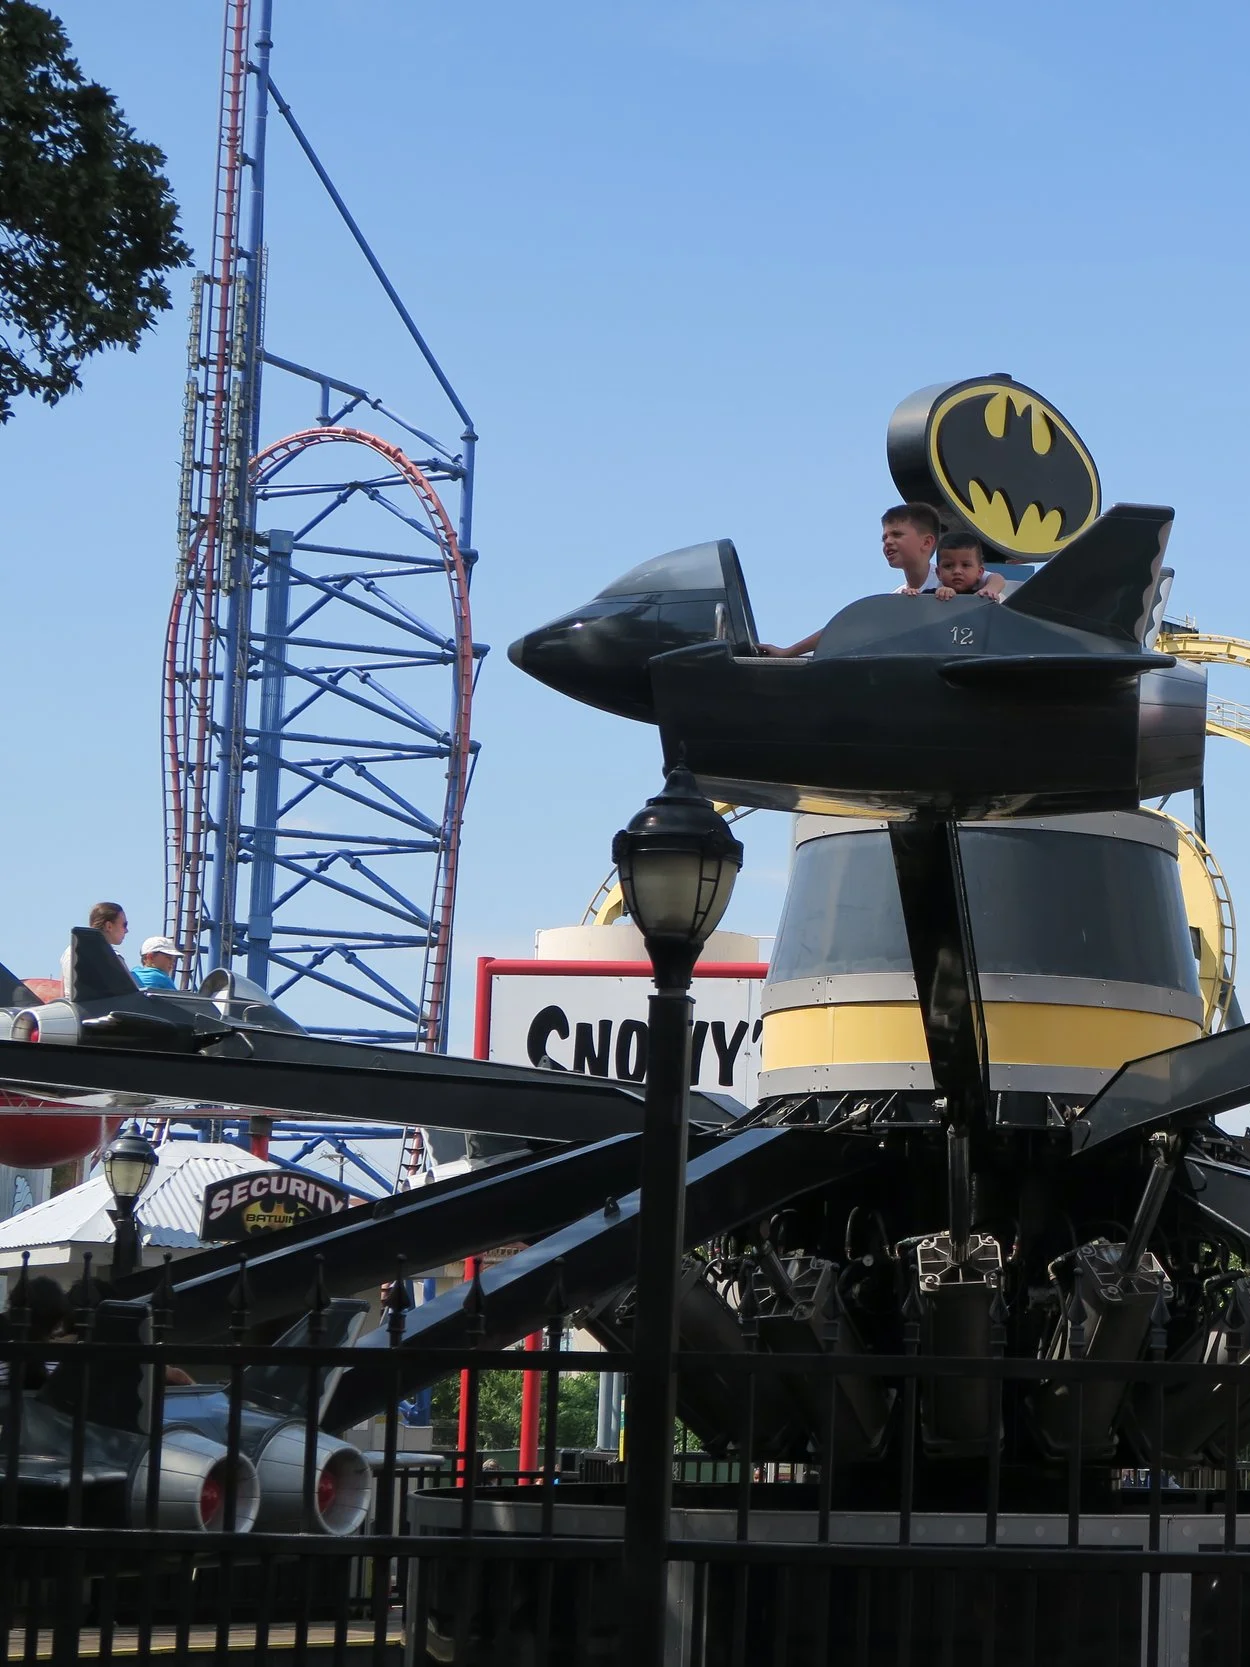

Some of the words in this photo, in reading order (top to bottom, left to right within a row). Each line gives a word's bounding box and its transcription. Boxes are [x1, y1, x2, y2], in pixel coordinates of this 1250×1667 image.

[950, 626, 974, 645] 12
[208, 1176, 344, 1221] SECURITY
[246, 1213, 297, 1224] BATWIN
